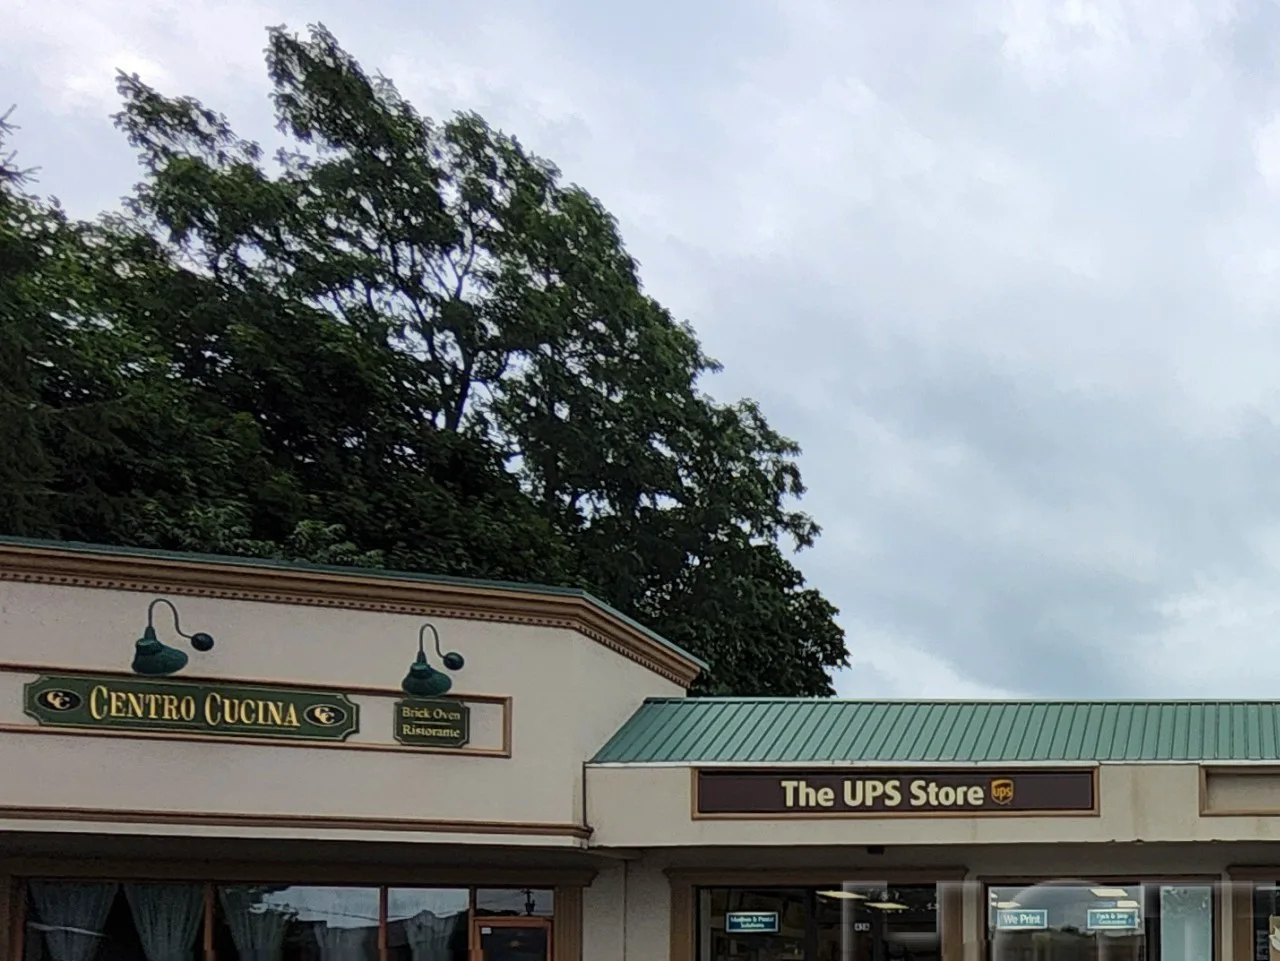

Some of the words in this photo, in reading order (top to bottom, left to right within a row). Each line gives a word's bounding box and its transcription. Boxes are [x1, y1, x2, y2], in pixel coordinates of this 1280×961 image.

[90, 685, 196, 721] CENTRO
[204, 692, 300, 727] CUCINA
[402, 706, 431, 718] Brick
[433, 708, 461, 720] Oven
[402, 724, 461, 738] Ristorante
[781, 780, 835, 807] The
[844, 780, 901, 806] UPS
[910, 780, 984, 806] Store
[1003, 913, 1018, 925] We
[1020, 913, 1041, 925] Print
